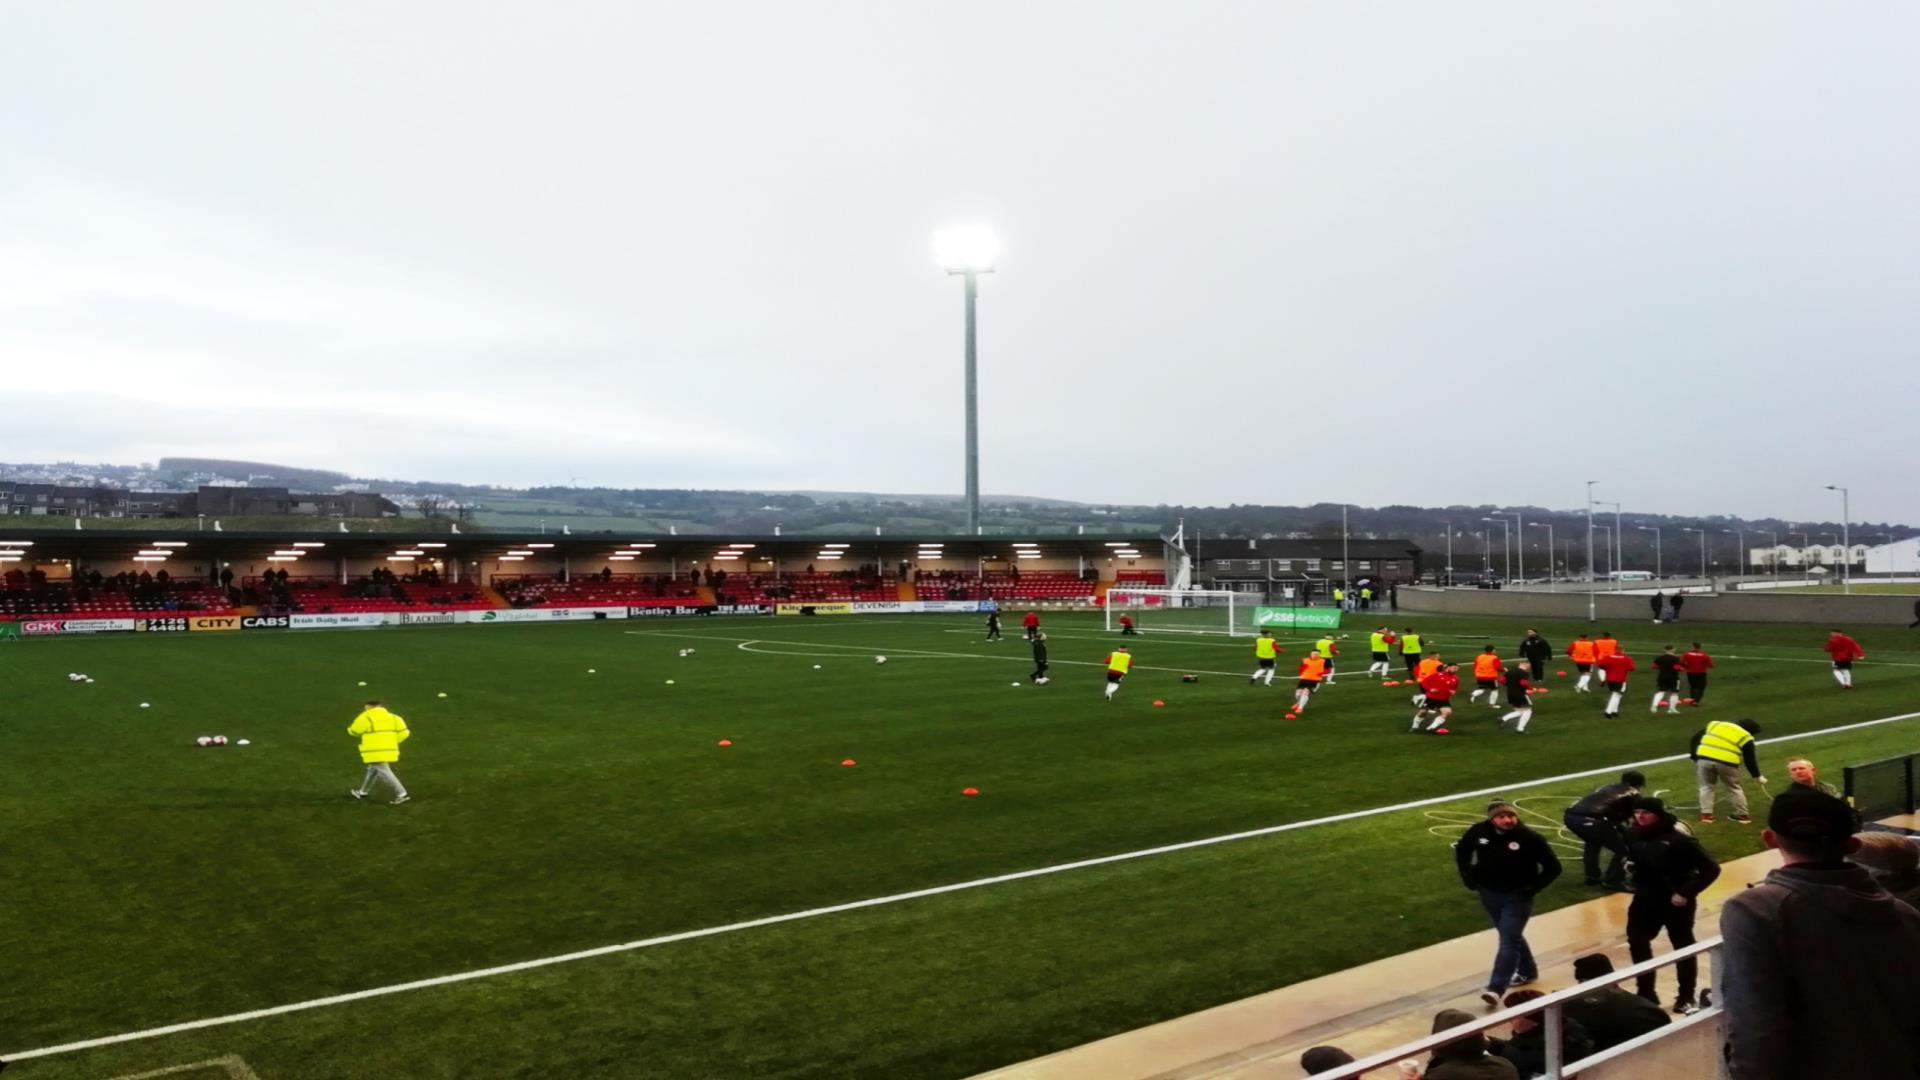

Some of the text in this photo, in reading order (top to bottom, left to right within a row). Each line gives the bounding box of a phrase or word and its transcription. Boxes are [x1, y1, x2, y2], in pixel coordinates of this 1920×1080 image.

[630, 606, 671, 616] Bentley
[675, 605, 698, 615] Bar
[852, 602, 900, 611] DEVENISH
[242, 616, 288, 627] CABS
[316, 616, 339, 625] Daily
[1272, 613, 1295, 622] sse
[25, 622, 58, 632] GMK
[197, 618, 235, 628] CITY
